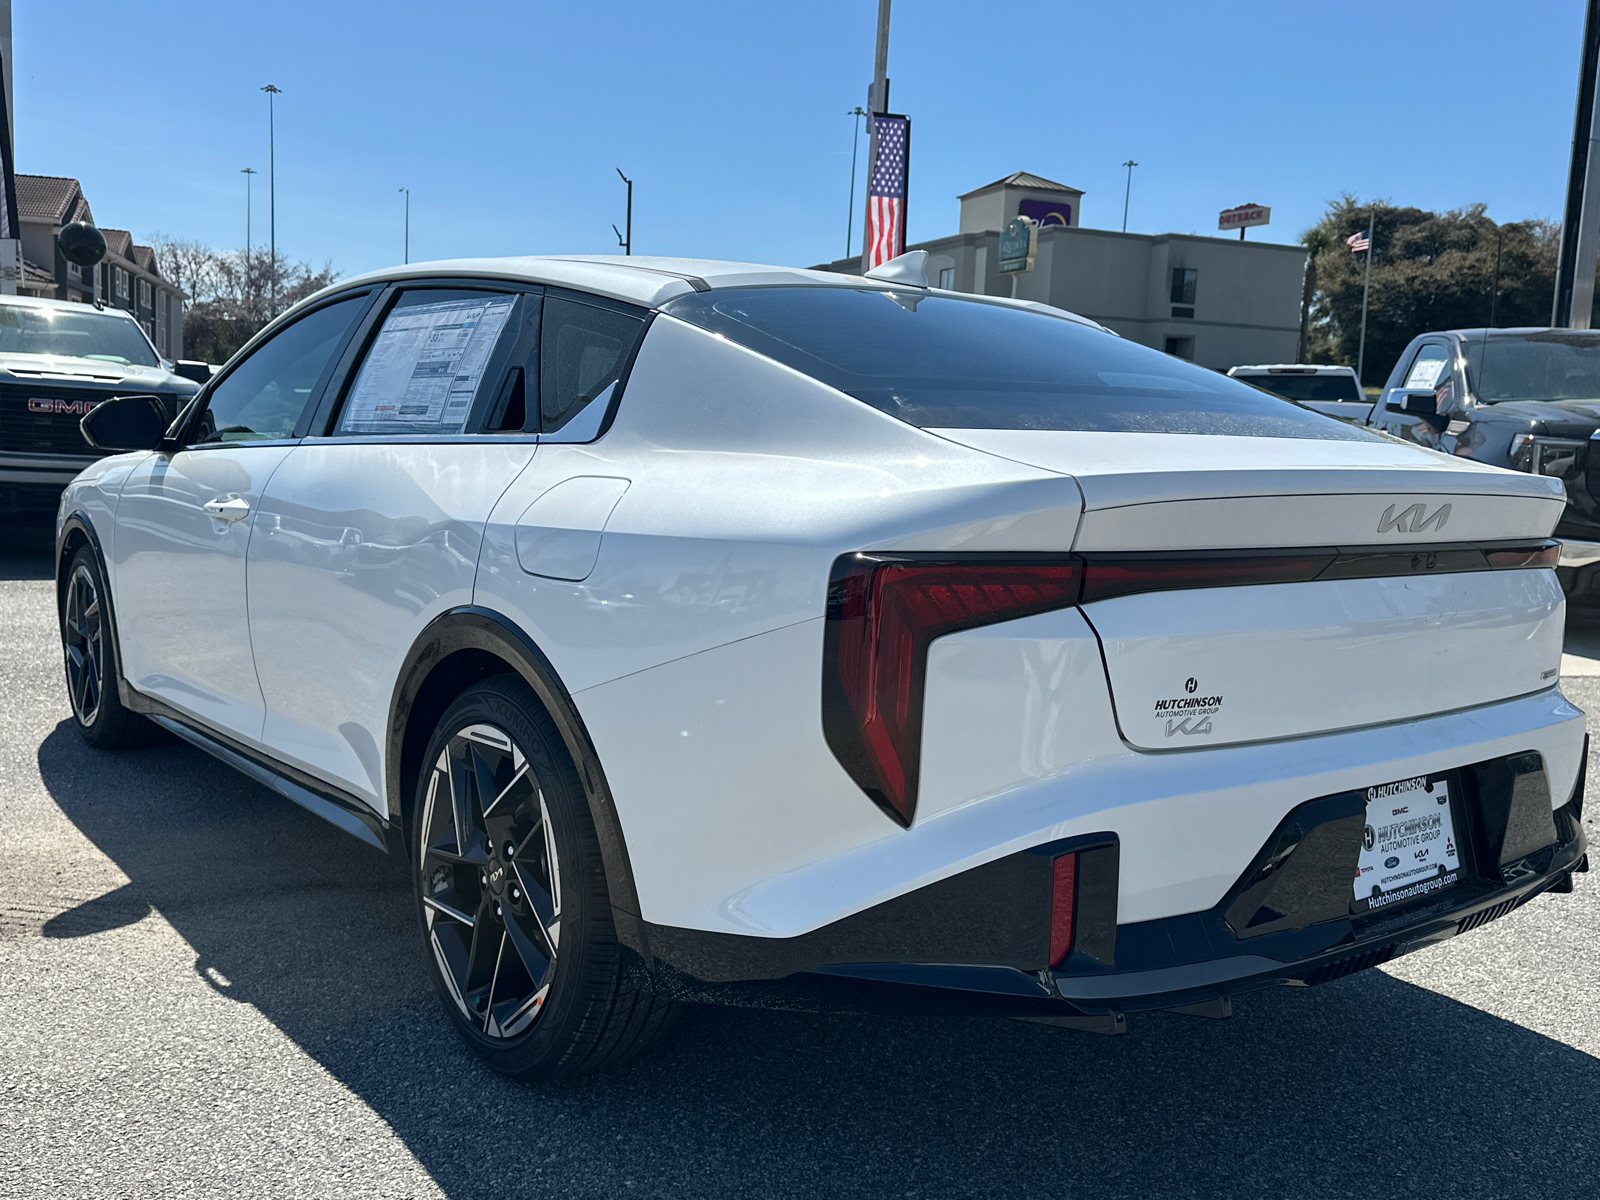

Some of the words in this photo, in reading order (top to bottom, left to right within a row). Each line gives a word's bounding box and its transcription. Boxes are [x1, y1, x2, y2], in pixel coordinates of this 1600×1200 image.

[1219, 210, 1263, 225] OUTBACK
[1377, 503, 1452, 533] KIA
[1154, 696, 1223, 711] HUTCHINSON
[1155, 709, 1197, 718] AUTOMOTIVE
[1198, 707, 1219, 716] GROUP
[494, 700, 541, 756] KUMHO
[1165, 716, 1212, 737] K4
[1378, 776, 1427, 799] HUTCHINSON
[1392, 806, 1409, 816] GMC
[1377, 812, 1443, 843] HUTCHINSON
[1380, 836, 1420, 854] AUTOMOTIVE
[1420, 829, 1441, 843] GROUP
[1414, 848, 1429, 859] KIA
[1360, 866, 1374, 874] TOYOTA
[1368, 872, 1458, 910] Hutchinsonautogroup.com
